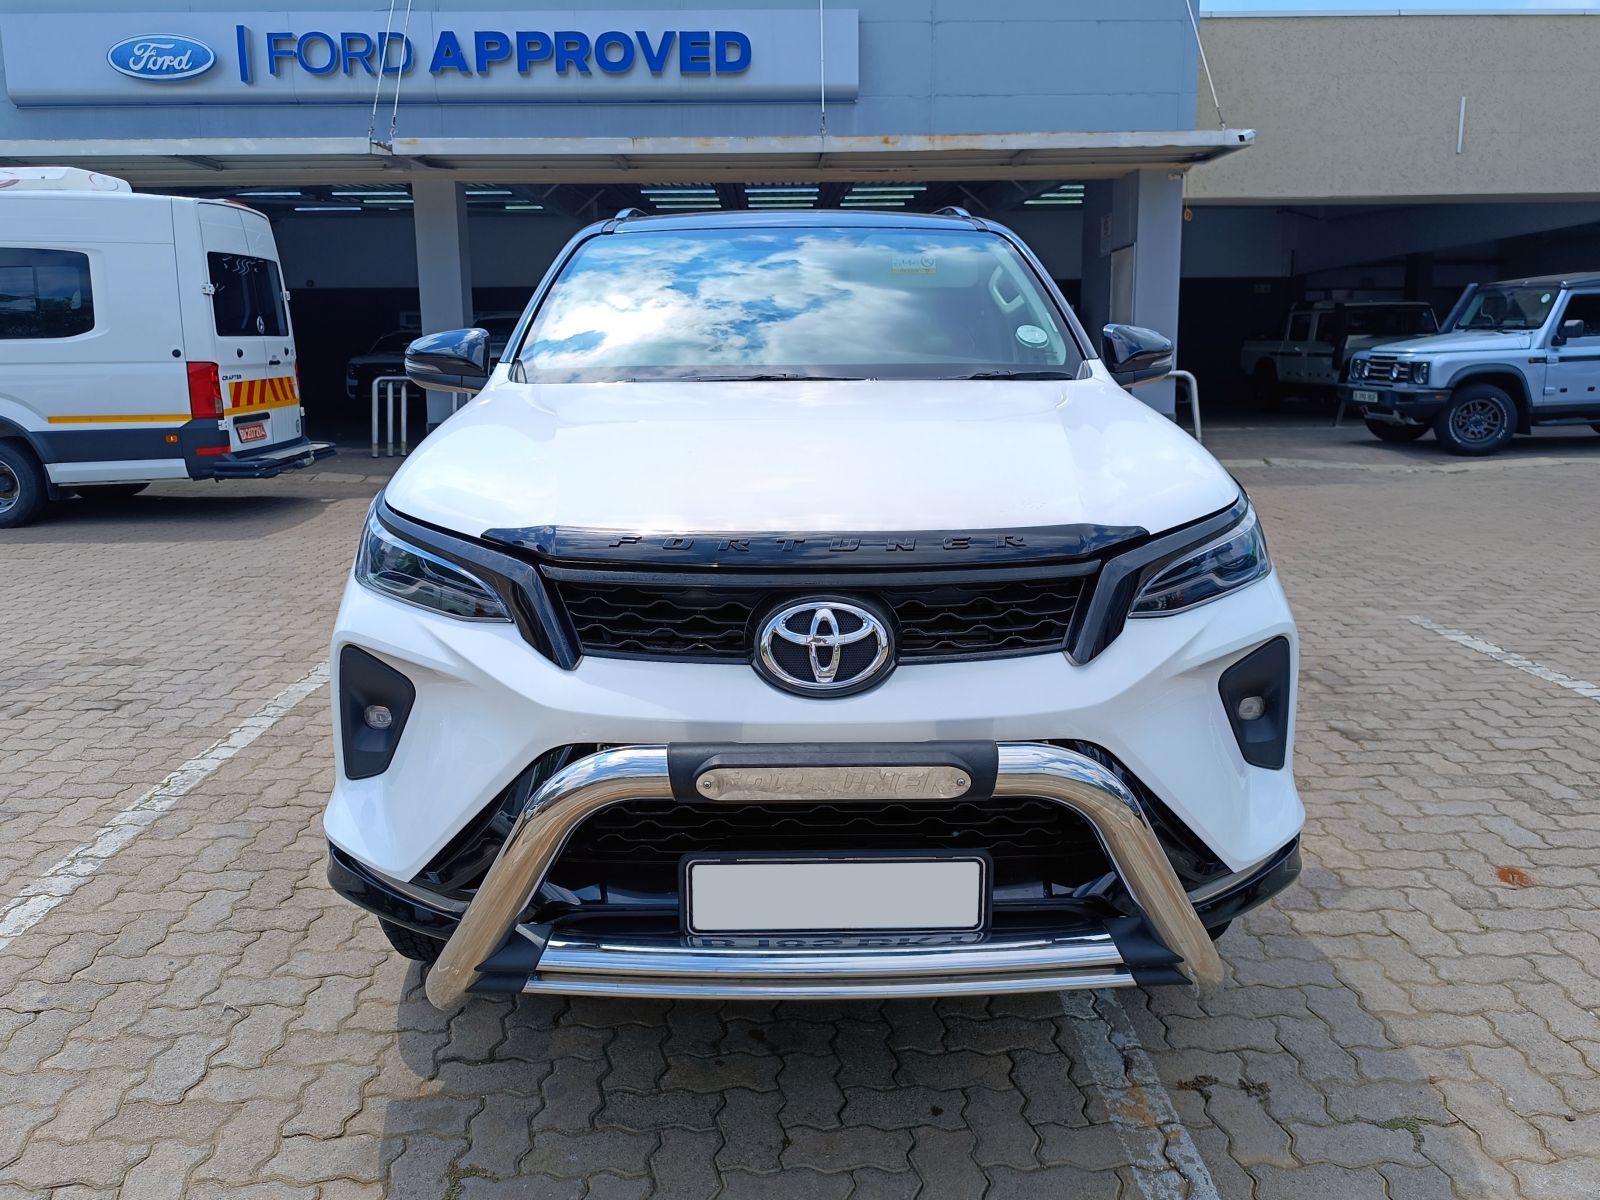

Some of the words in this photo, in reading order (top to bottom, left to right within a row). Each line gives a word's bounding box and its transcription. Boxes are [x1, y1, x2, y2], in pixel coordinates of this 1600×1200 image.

[128, 41, 194, 72] Ford
[266, 31, 414, 76] FORD
[429, 30, 753, 77] APPROVED
[608, 535, 1028, 552] FORTUNER
